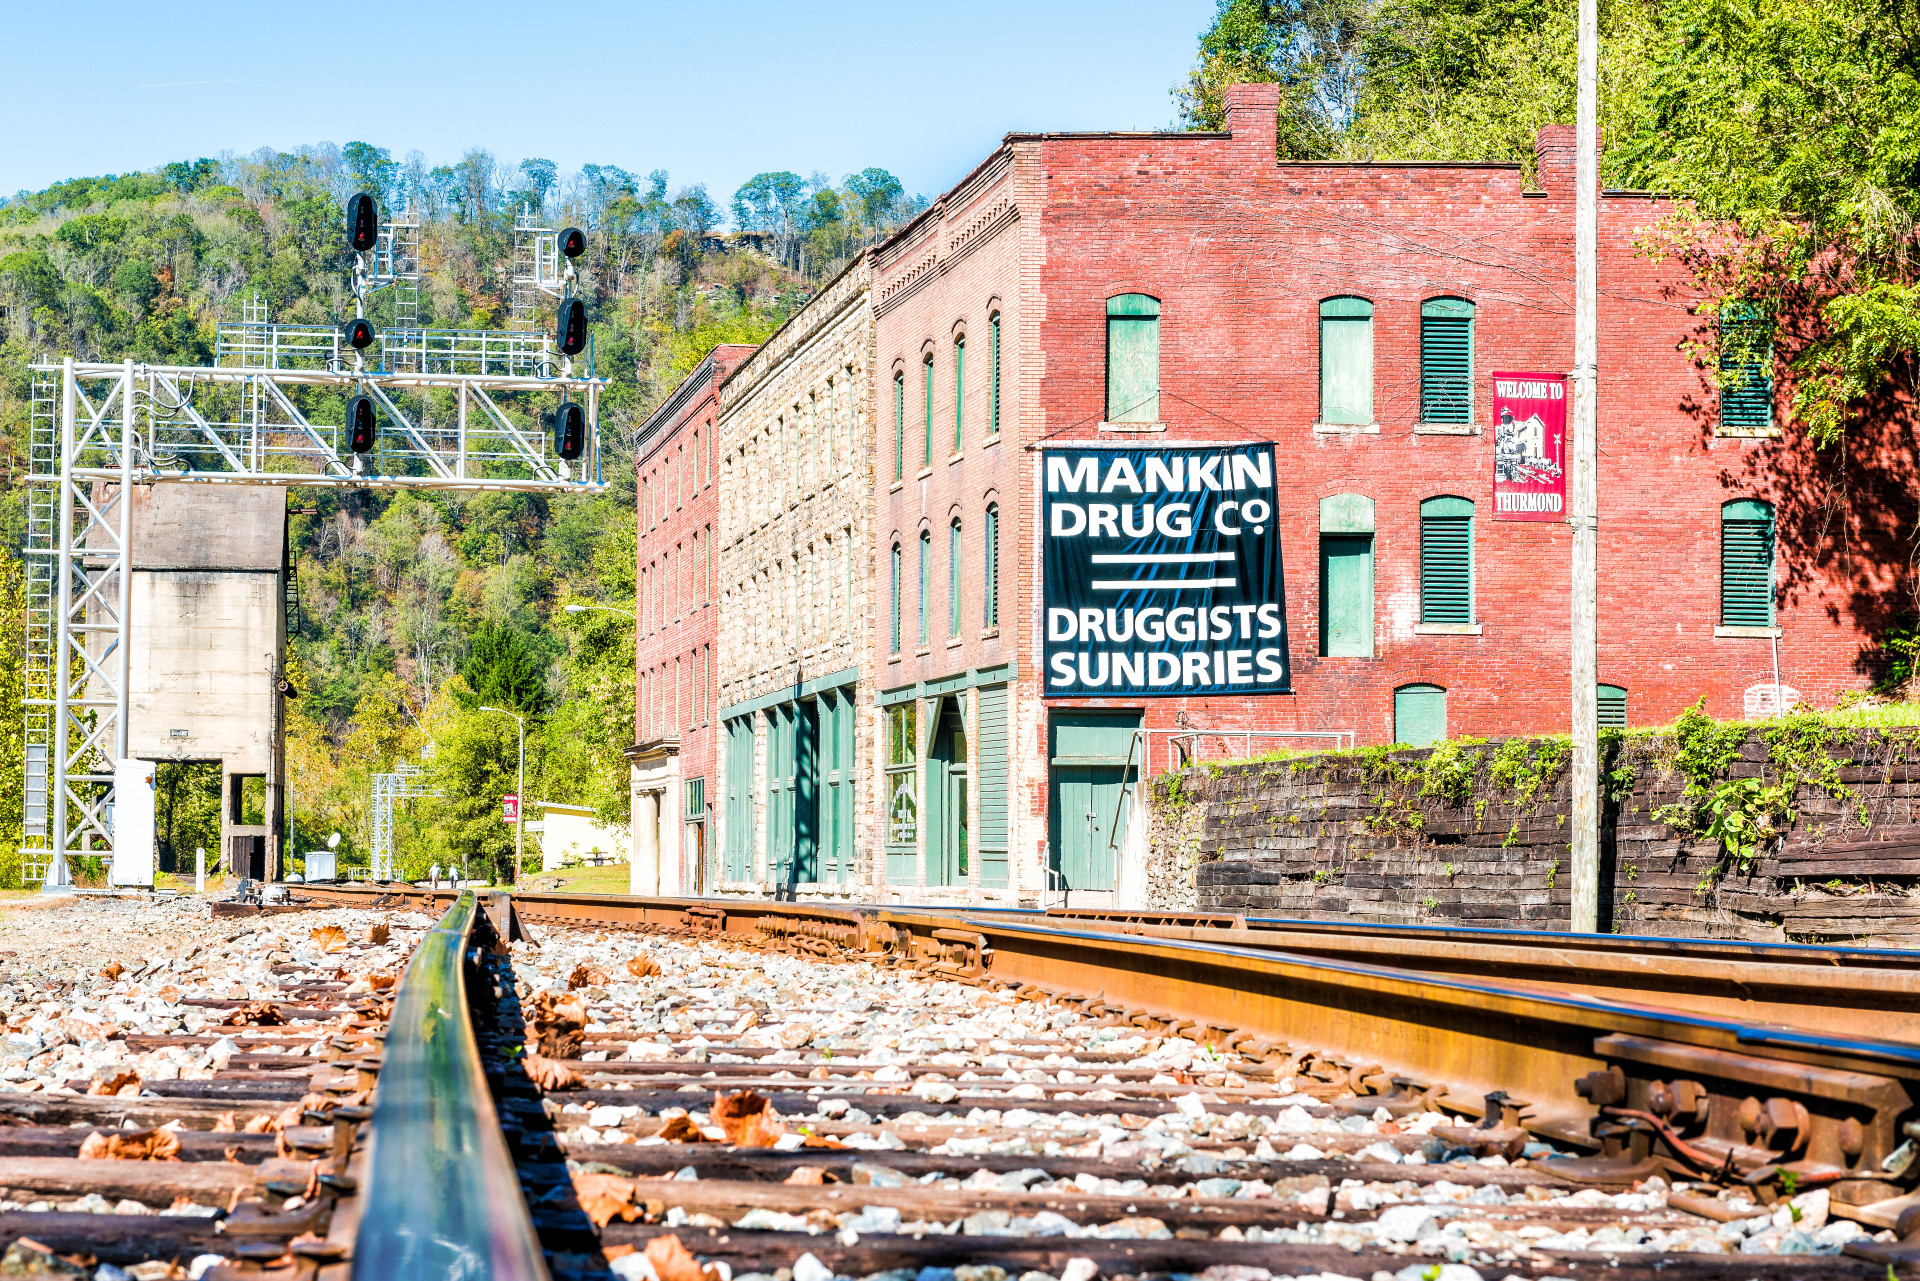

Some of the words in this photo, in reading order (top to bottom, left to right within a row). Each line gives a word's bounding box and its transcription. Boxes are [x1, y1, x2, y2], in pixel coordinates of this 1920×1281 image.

[1496, 381, 1547, 399] WELCOME
[1549, 382, 1563, 400] TO
[1047, 452, 1272, 493] MANKIN
[1051, 502, 1192, 538] DRUG
[1495, 492, 1562, 512] THURMOND
[1048, 603, 1281, 643] DRUGGISTS
[1050, 648, 1283, 687] SUNDRIES
